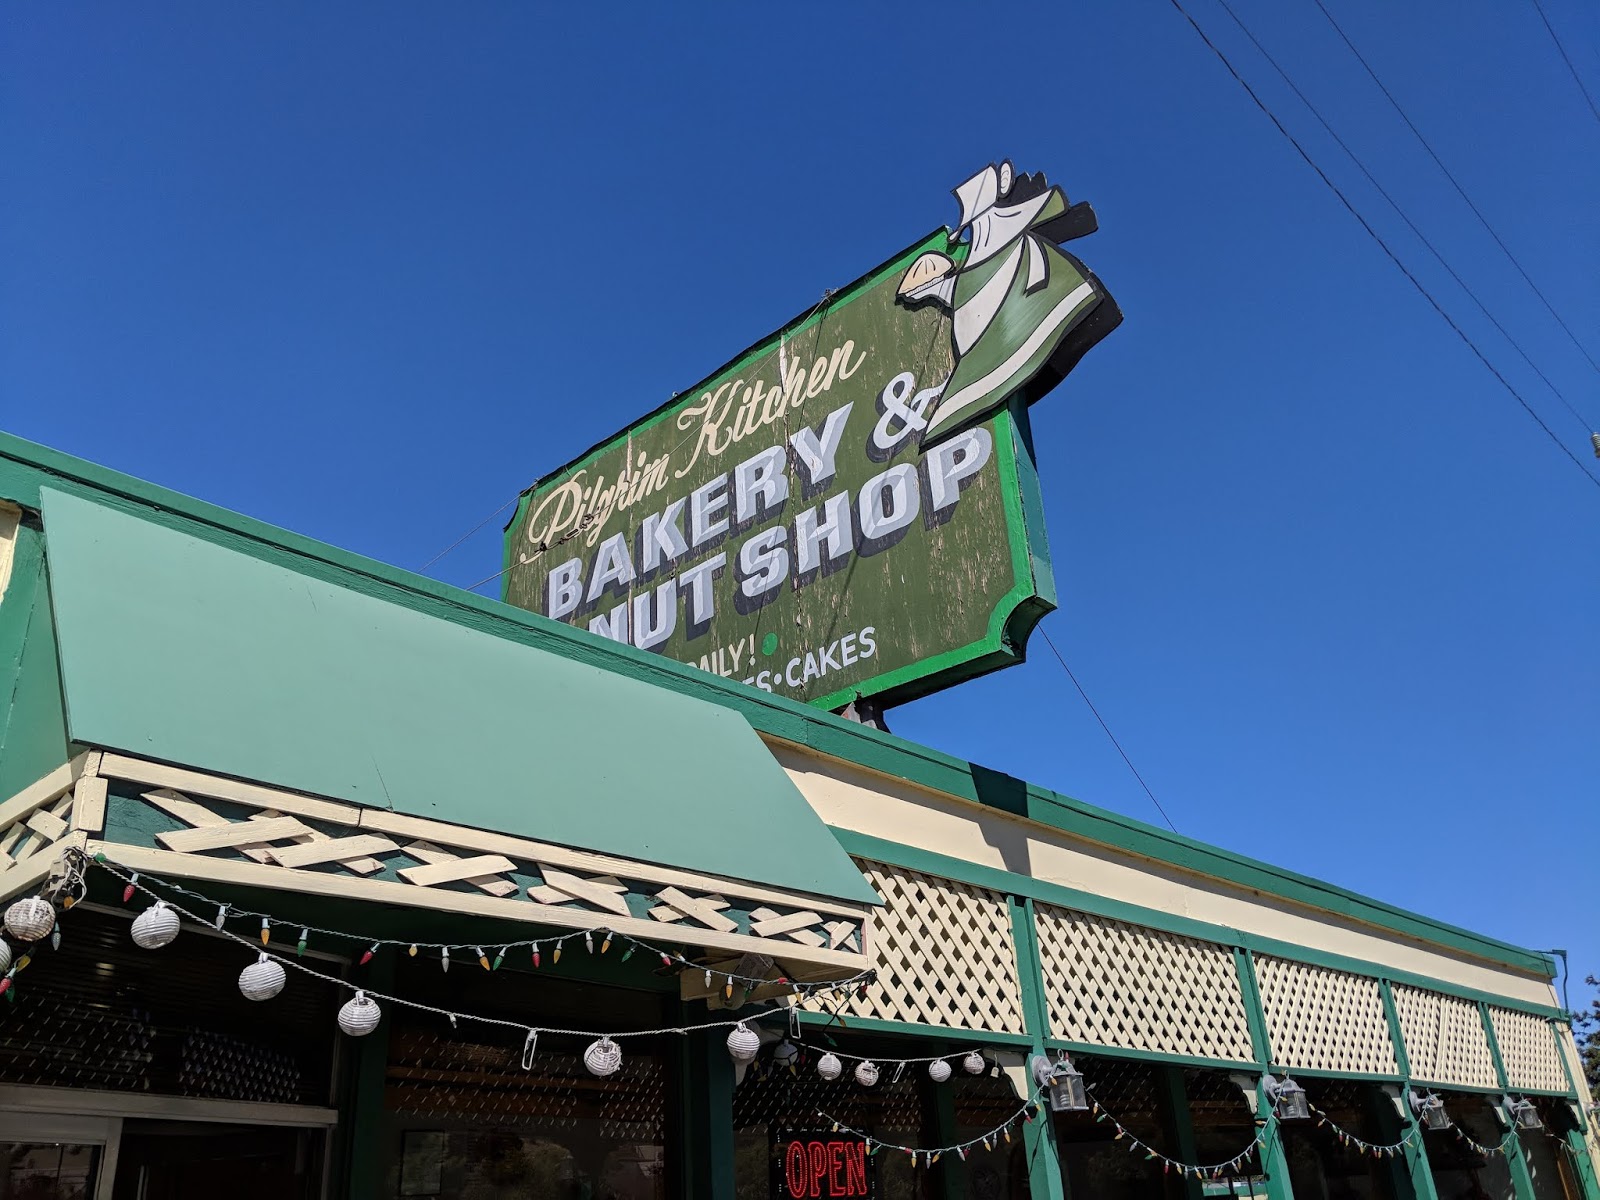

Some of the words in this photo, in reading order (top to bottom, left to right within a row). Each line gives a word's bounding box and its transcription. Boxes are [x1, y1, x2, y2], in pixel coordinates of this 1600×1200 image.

[520, 451, 670, 565] Pilgrim
[675, 339, 867, 480] Kitchen
[548, 400, 855, 620] BAKERY
[873, 371, 950, 449] &
[740, 427, 992, 599] SHOP
[685, 633, 756, 678] AILY!
[786, 1141, 867, 1198] OPEN
